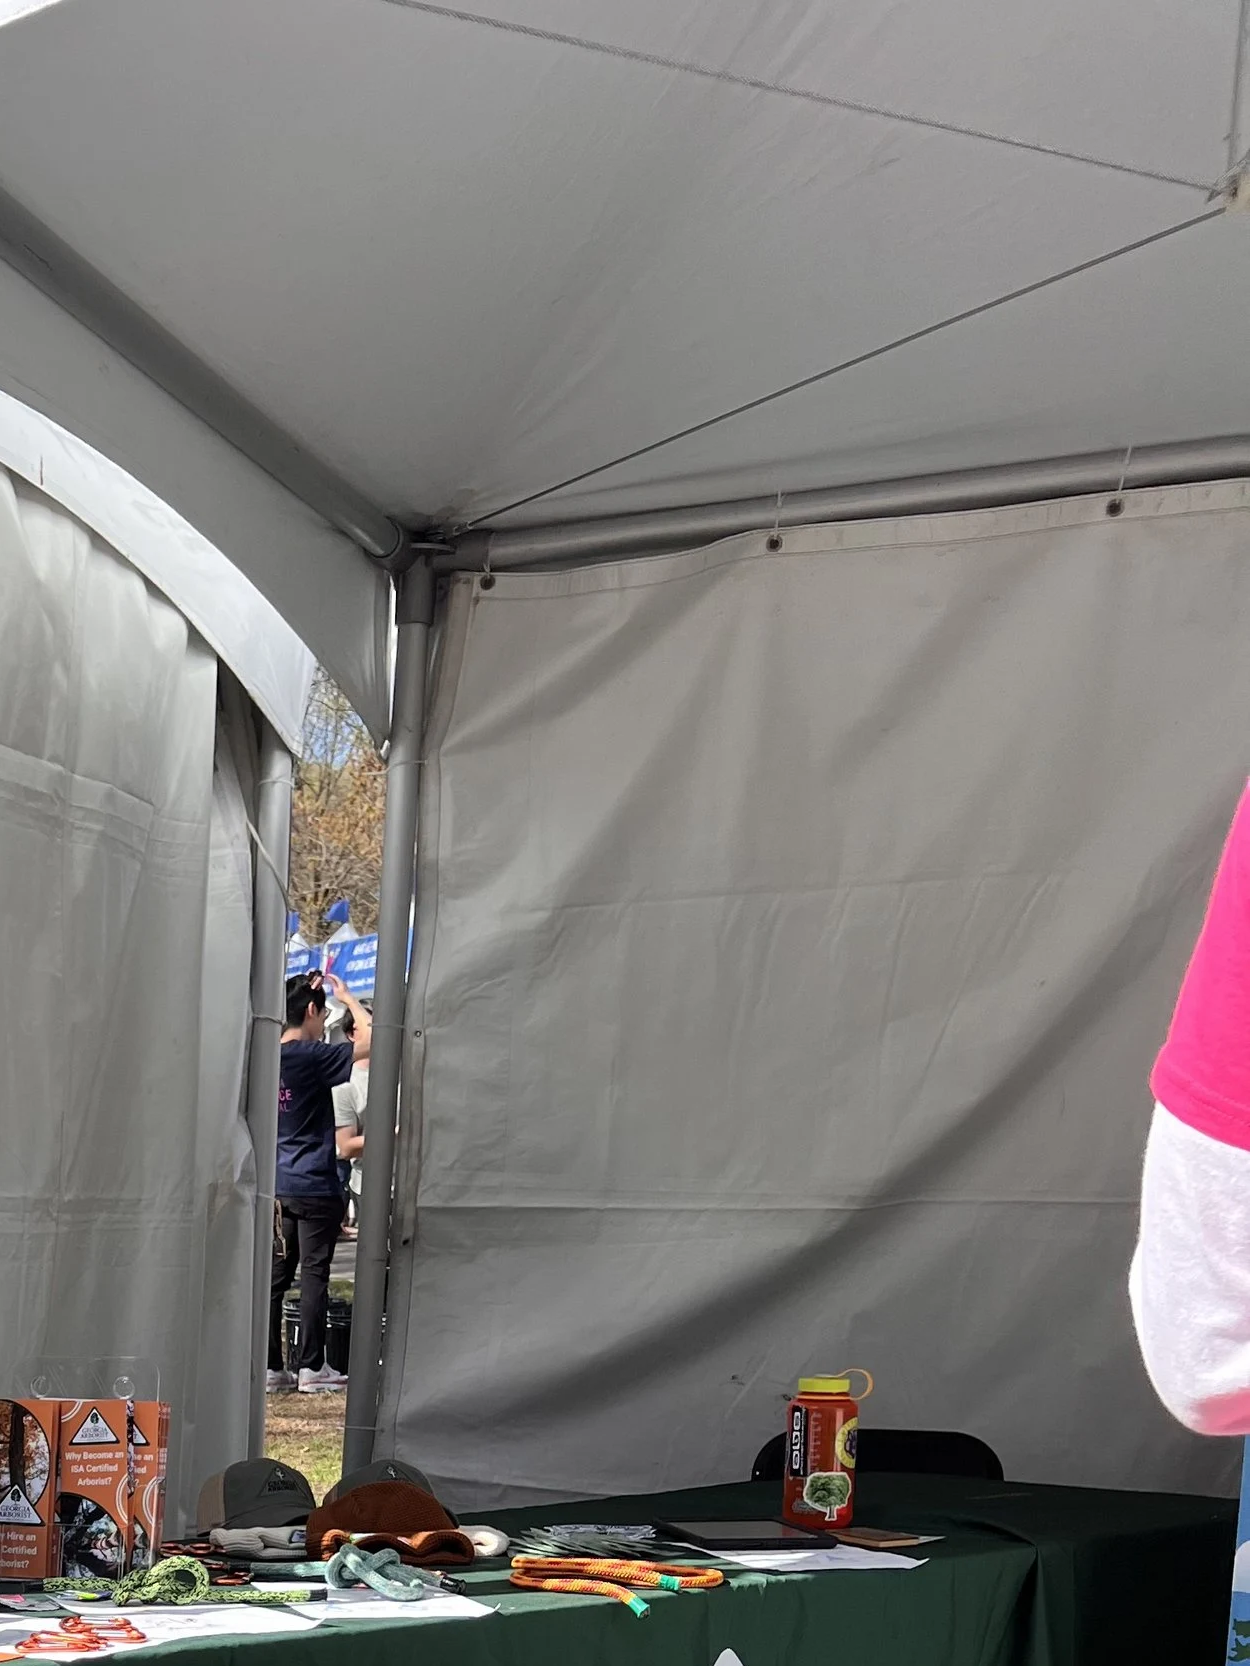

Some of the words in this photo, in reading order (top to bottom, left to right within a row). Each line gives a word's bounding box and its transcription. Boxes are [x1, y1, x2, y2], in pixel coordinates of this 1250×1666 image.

[65, 1452, 82, 1461] Why
[83, 1452, 114, 1460] Become
[71, 1464, 85, 1473] ISA
[86, 1463, 119, 1473] Certified
[78, 1477, 113, 1486] Arborist?
[6, 1531, 24, 1541] Hire
[1, 1545, 37, 1555] Certified
